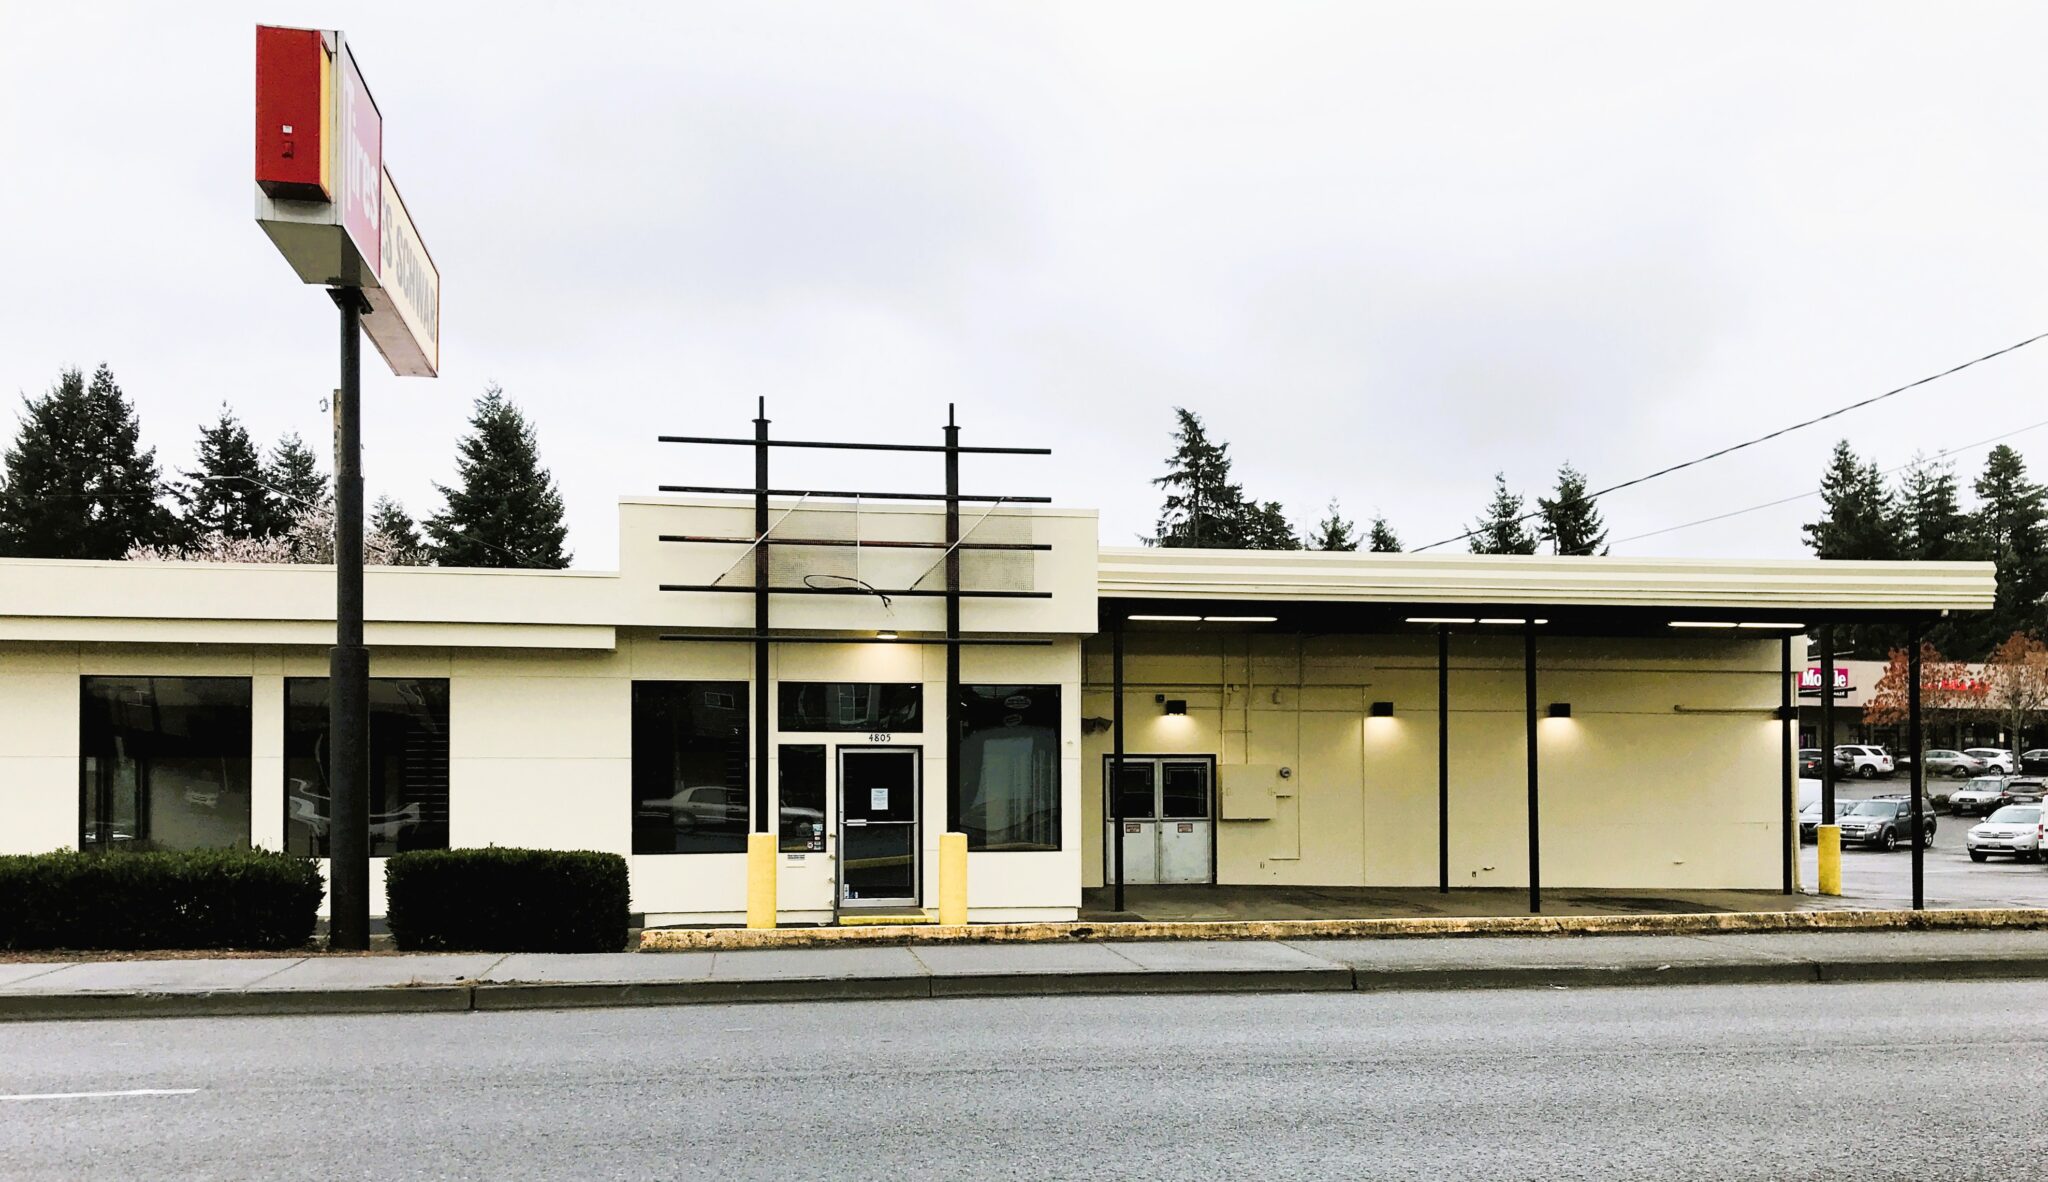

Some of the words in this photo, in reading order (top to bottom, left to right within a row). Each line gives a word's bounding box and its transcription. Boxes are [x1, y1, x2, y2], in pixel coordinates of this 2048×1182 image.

[345, 73, 379, 230] Tires
[396, 224, 436, 343] SCHWAB
[1801, 669, 1847, 687] Mole
[869, 733, 891, 742] 4805
